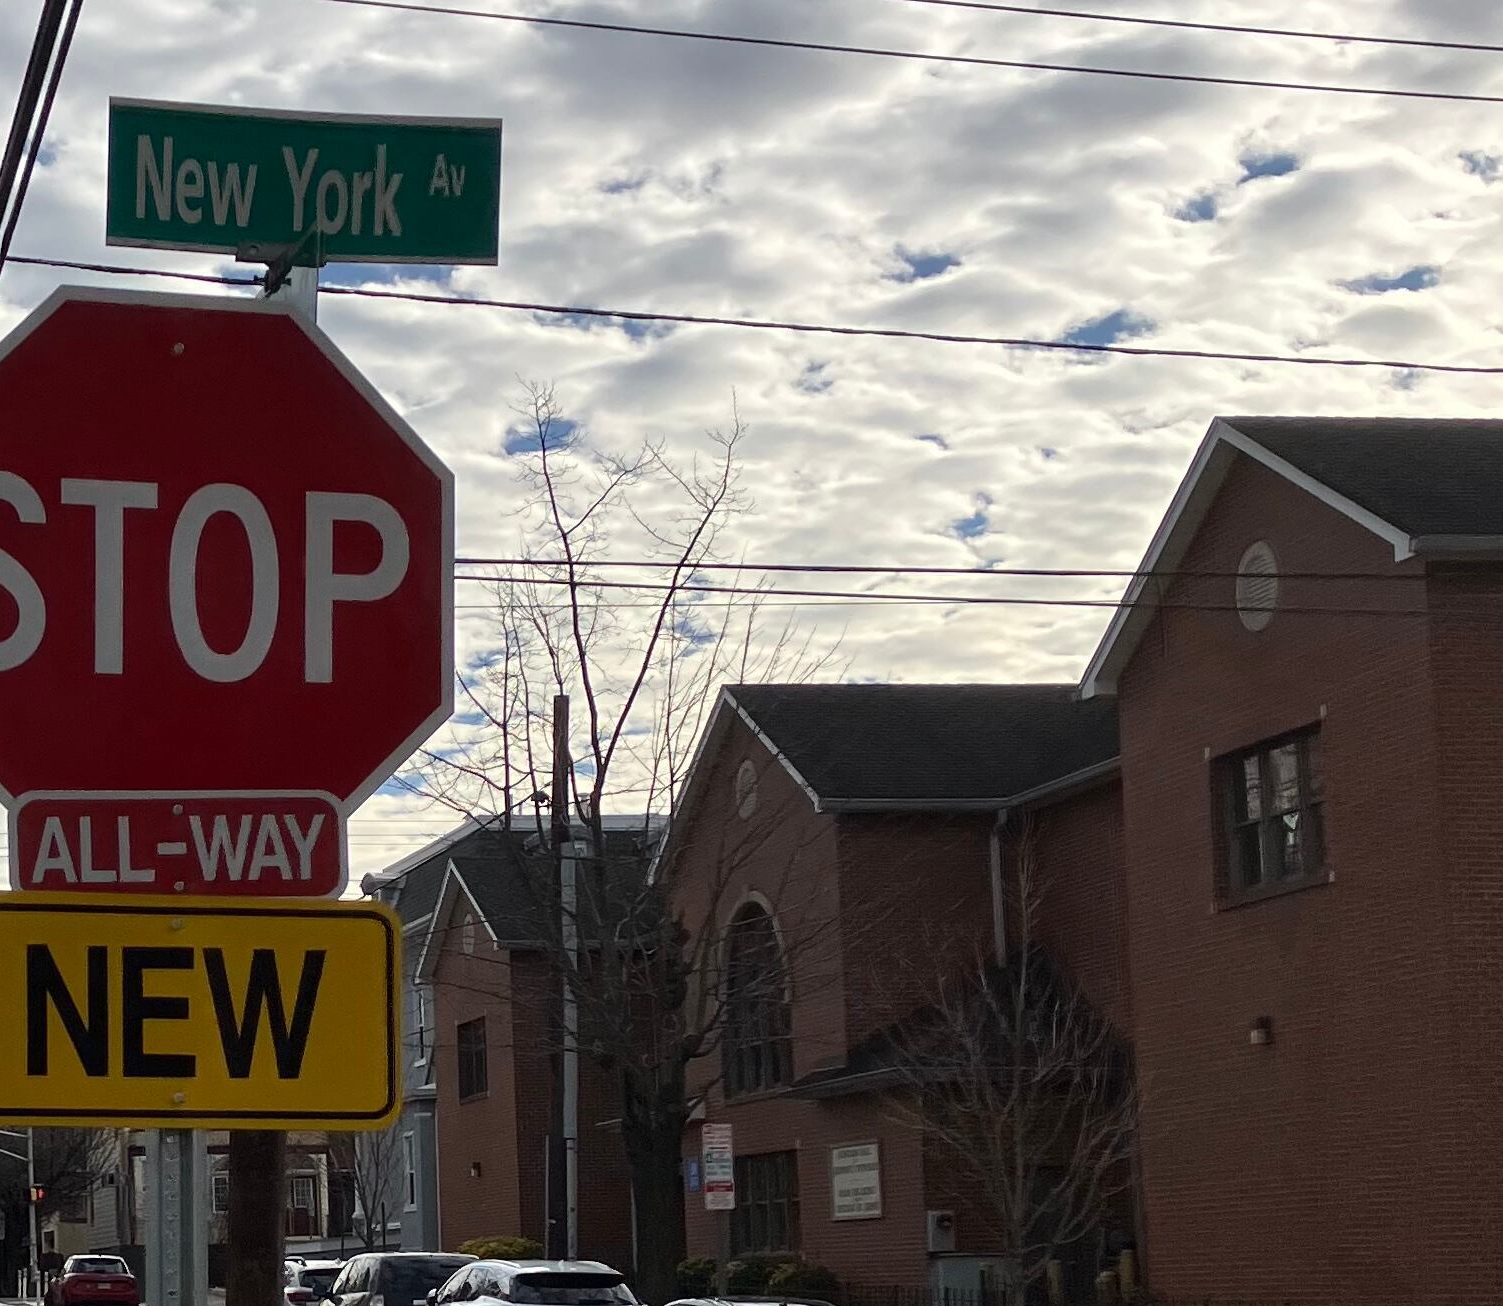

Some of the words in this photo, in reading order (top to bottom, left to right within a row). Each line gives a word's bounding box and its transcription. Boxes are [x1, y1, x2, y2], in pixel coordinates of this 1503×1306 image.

[135, 134, 257, 227] New
[282, 143, 403, 236] York
[429, 153, 466, 199] Av
[32, 813, 325, 884] ALL-WAY
[26, 943, 327, 1079] NEW
